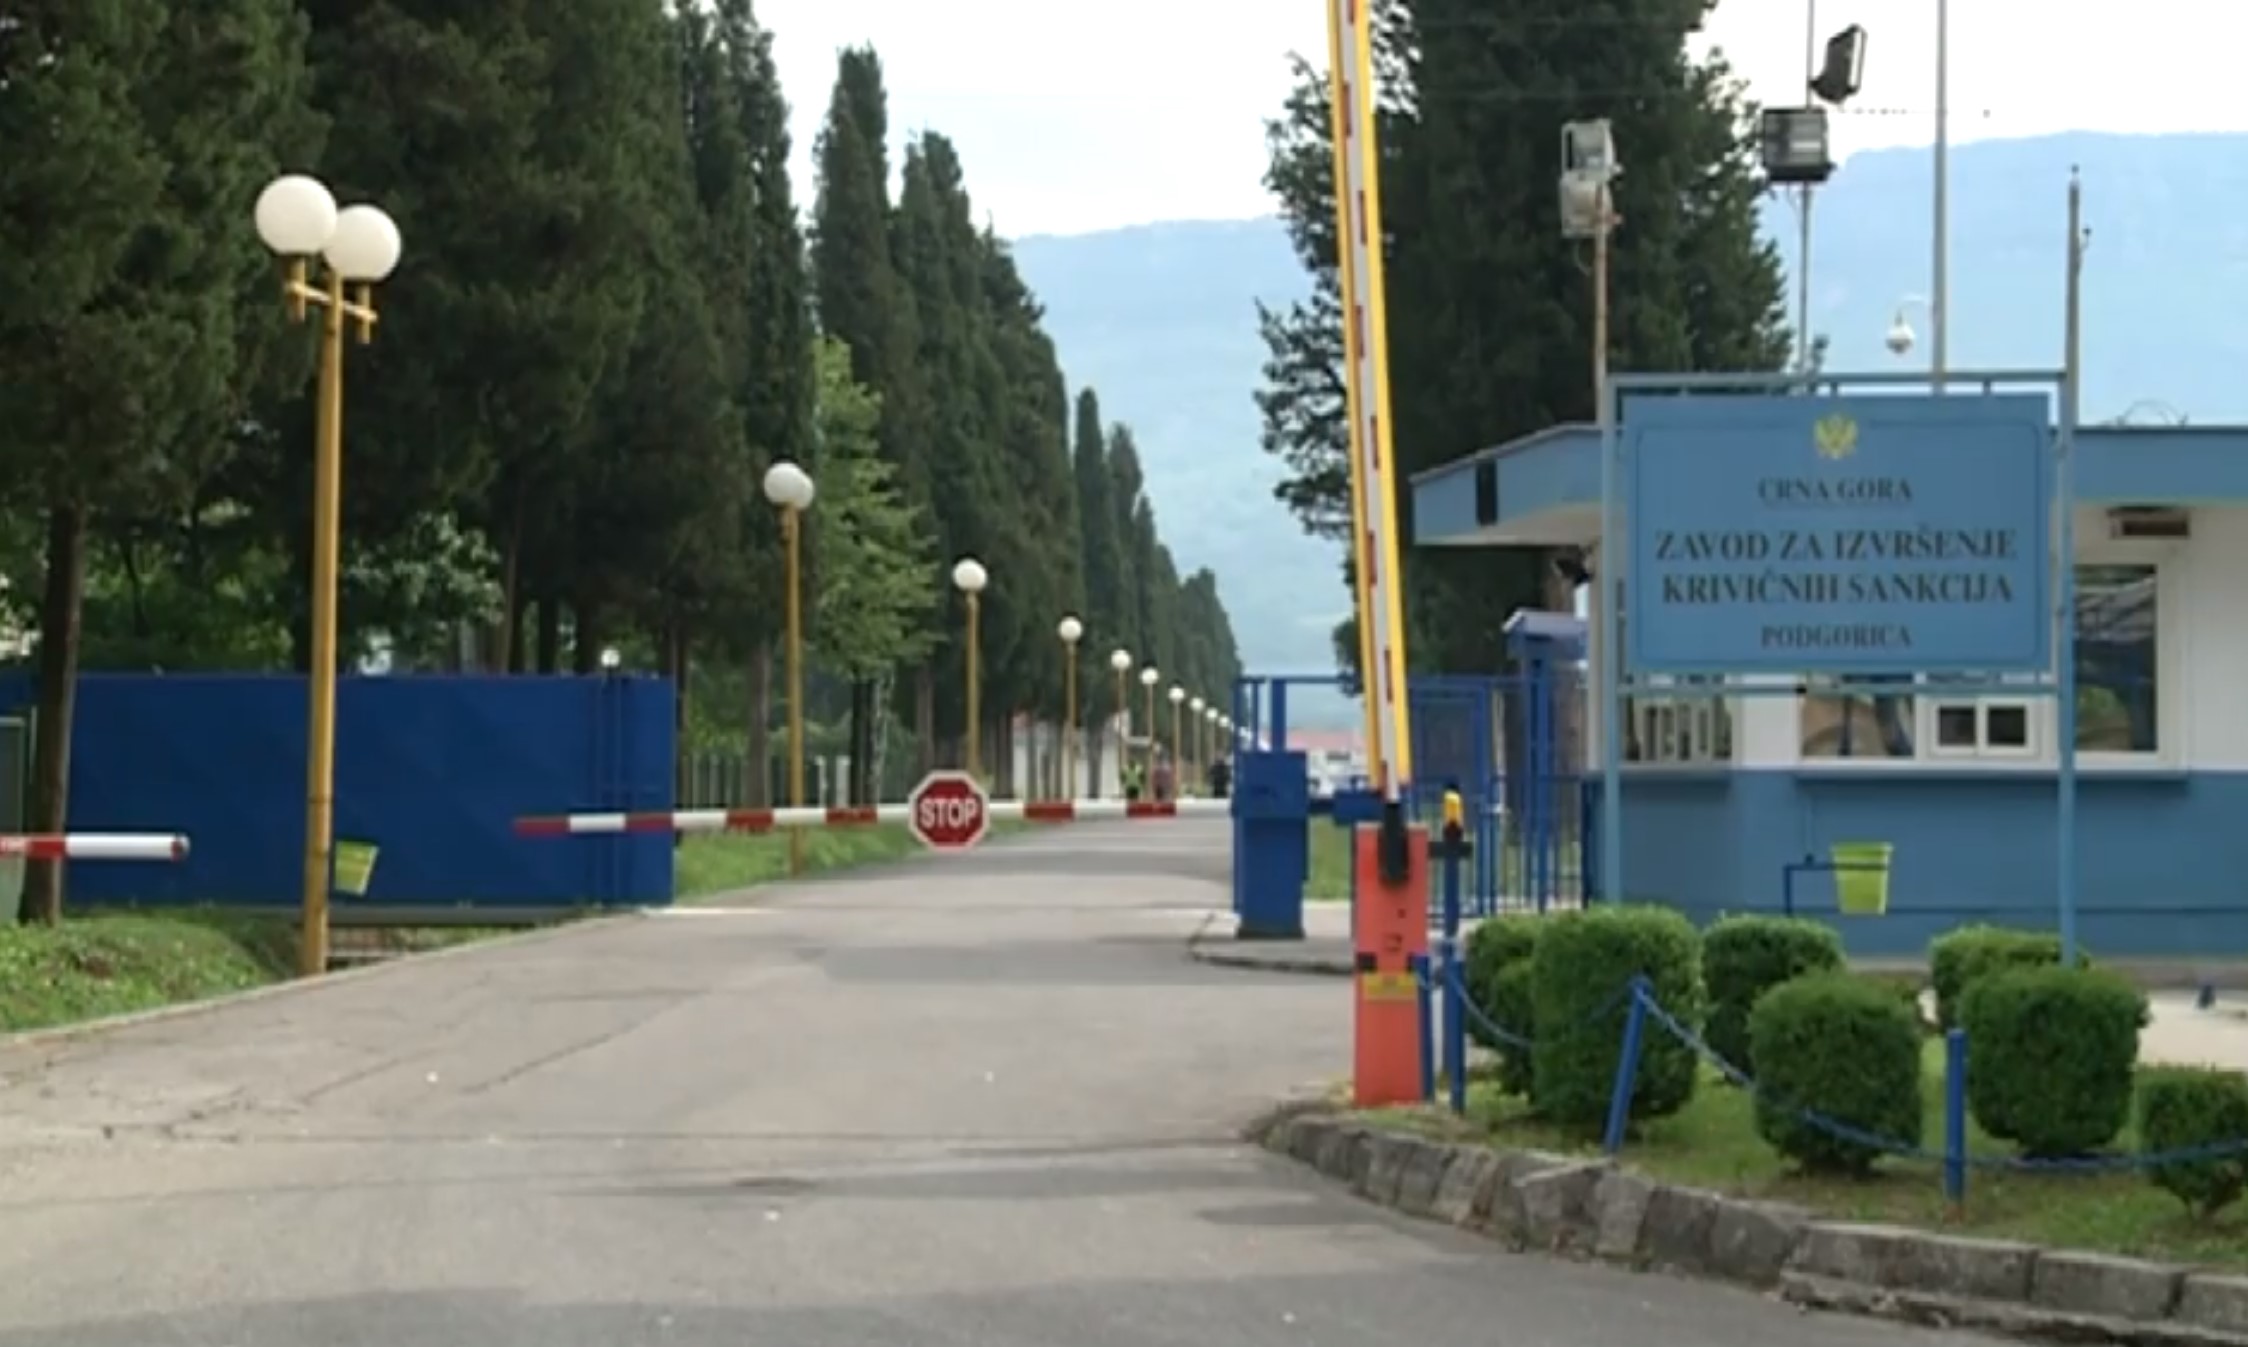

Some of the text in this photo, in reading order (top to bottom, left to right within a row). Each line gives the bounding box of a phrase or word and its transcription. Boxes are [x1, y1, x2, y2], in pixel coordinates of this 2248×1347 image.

[1757, 477, 1912, 500] CRNA GORA
[1655, 522, 2018, 560] ZAVOD ZA IZVRŠENJE
[1848, 572, 2012, 603] SANKCIJA
[1761, 624, 1912, 648] PODGORICA
[920, 797, 977, 829] STOP
